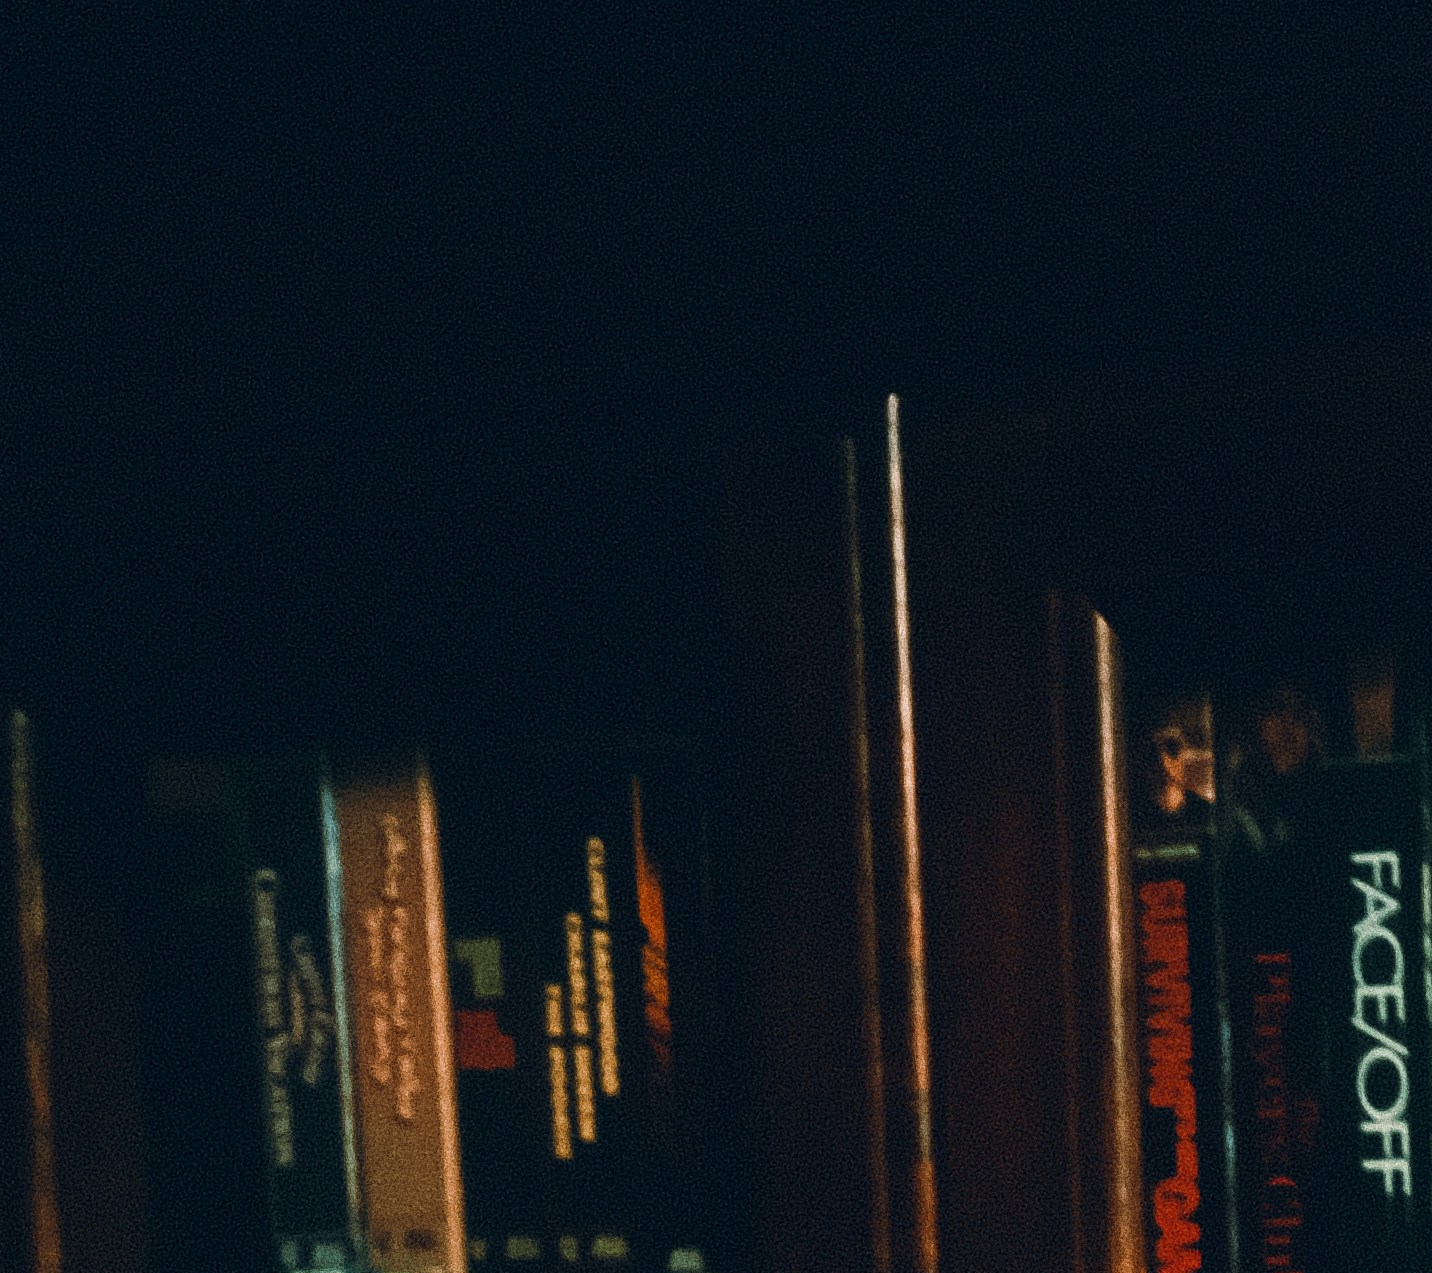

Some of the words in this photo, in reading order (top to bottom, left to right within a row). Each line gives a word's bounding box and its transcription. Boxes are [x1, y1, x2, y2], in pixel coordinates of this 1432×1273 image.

[586, 836, 610, 922] CLINT
[591, 928, 620, 1097] EASTWOOD
[1138, 879, 1197, 1108] SURVIVING
[1350, 850, 1413, 1196] FACE/OFF
